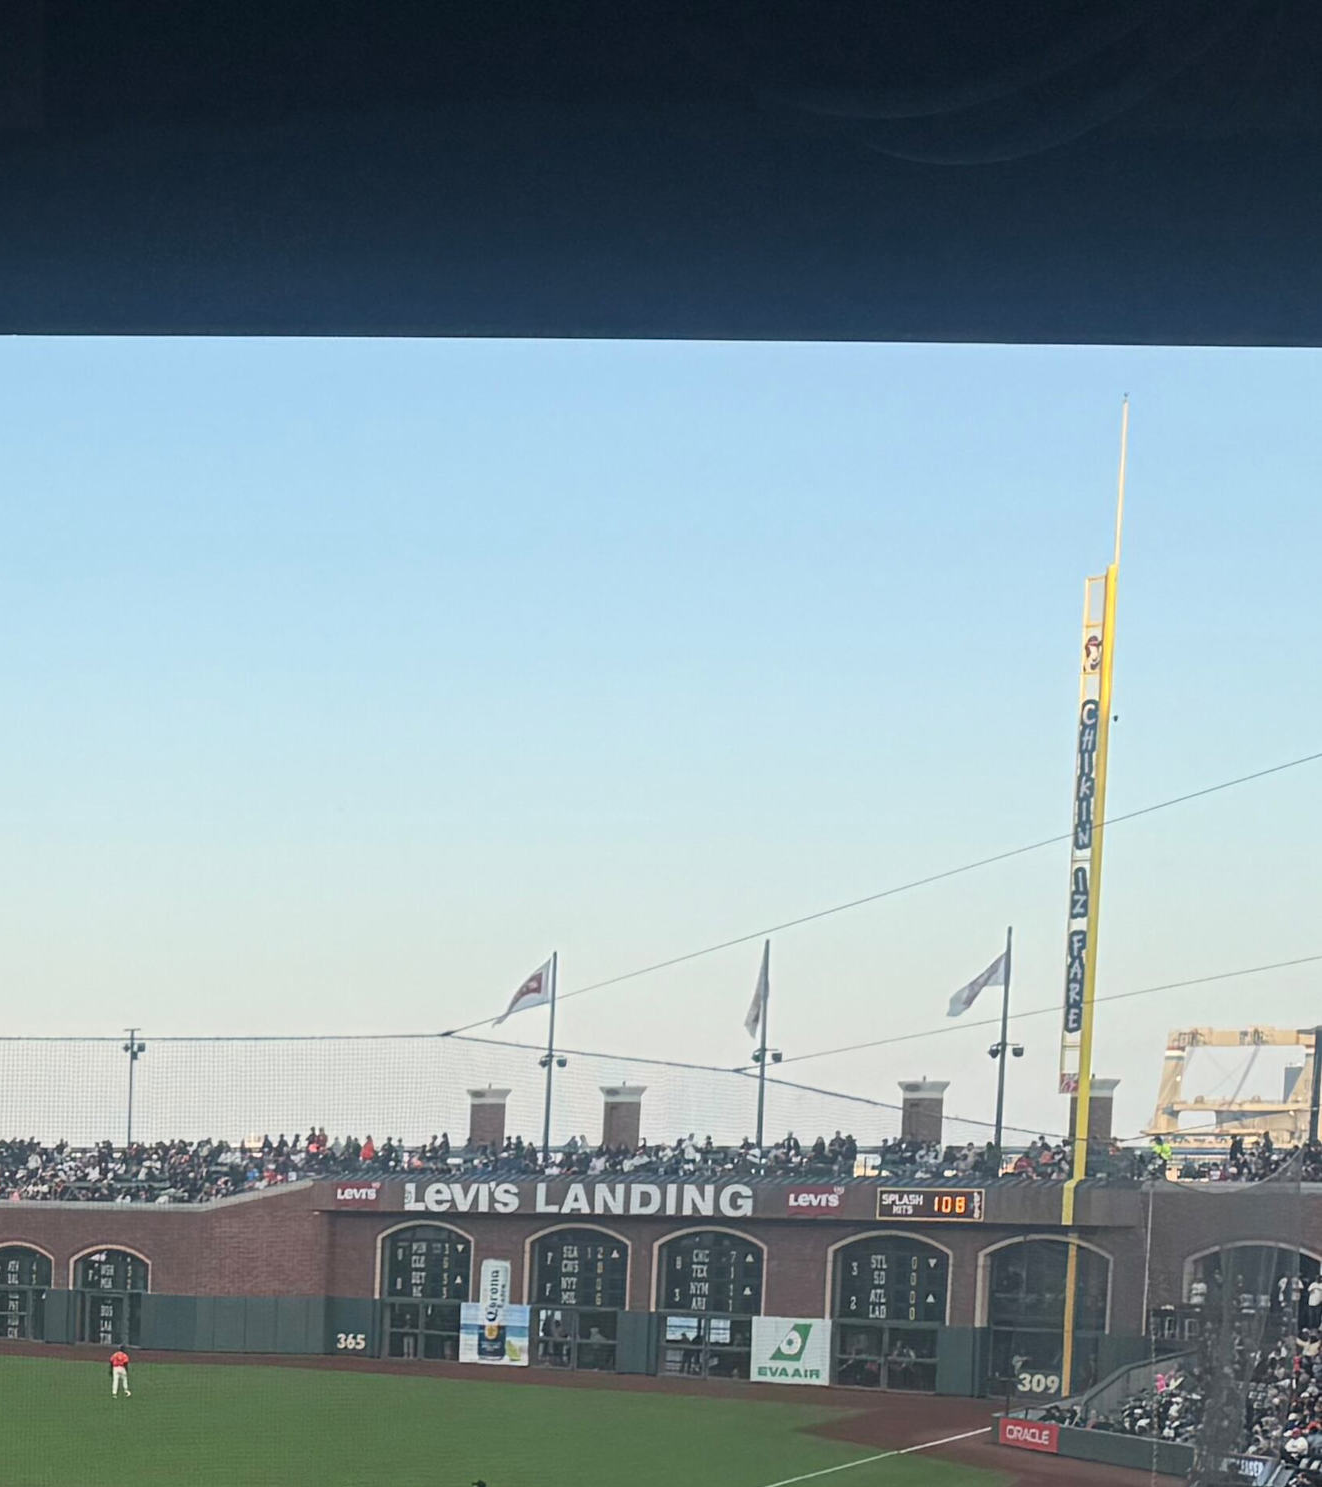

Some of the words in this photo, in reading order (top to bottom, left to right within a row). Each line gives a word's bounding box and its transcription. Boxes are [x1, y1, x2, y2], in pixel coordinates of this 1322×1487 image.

[1077, 700, 1099, 851] CHIKIN
[1072, 867, 1088, 918] IZ
[1065, 931, 1086, 1033] FARE
[536, 1184, 754, 1218] LANDING
[882, 1193, 923, 1206] SPLASH
[892, 1205, 913, 1215] HITS
[852, 1262, 858, 1276] 3
[871, 1255, 887, 1269] STL
[873, 1271, 886, 1284] SD
[486, 1269, 500, 1322] Corona
[869, 1289, 886, 1303] ATL
[850, 1296, 856, 1310] 2
[869, 1305, 886, 1318] LAD
[337, 1333, 366, 1350] 365
[758, 1366, 786, 1378] EVA
[789, 1368, 820, 1380] AIR
[1017, 1373, 1059, 1394] 309
[1006, 1425, 1050, 1445] ORACLE
